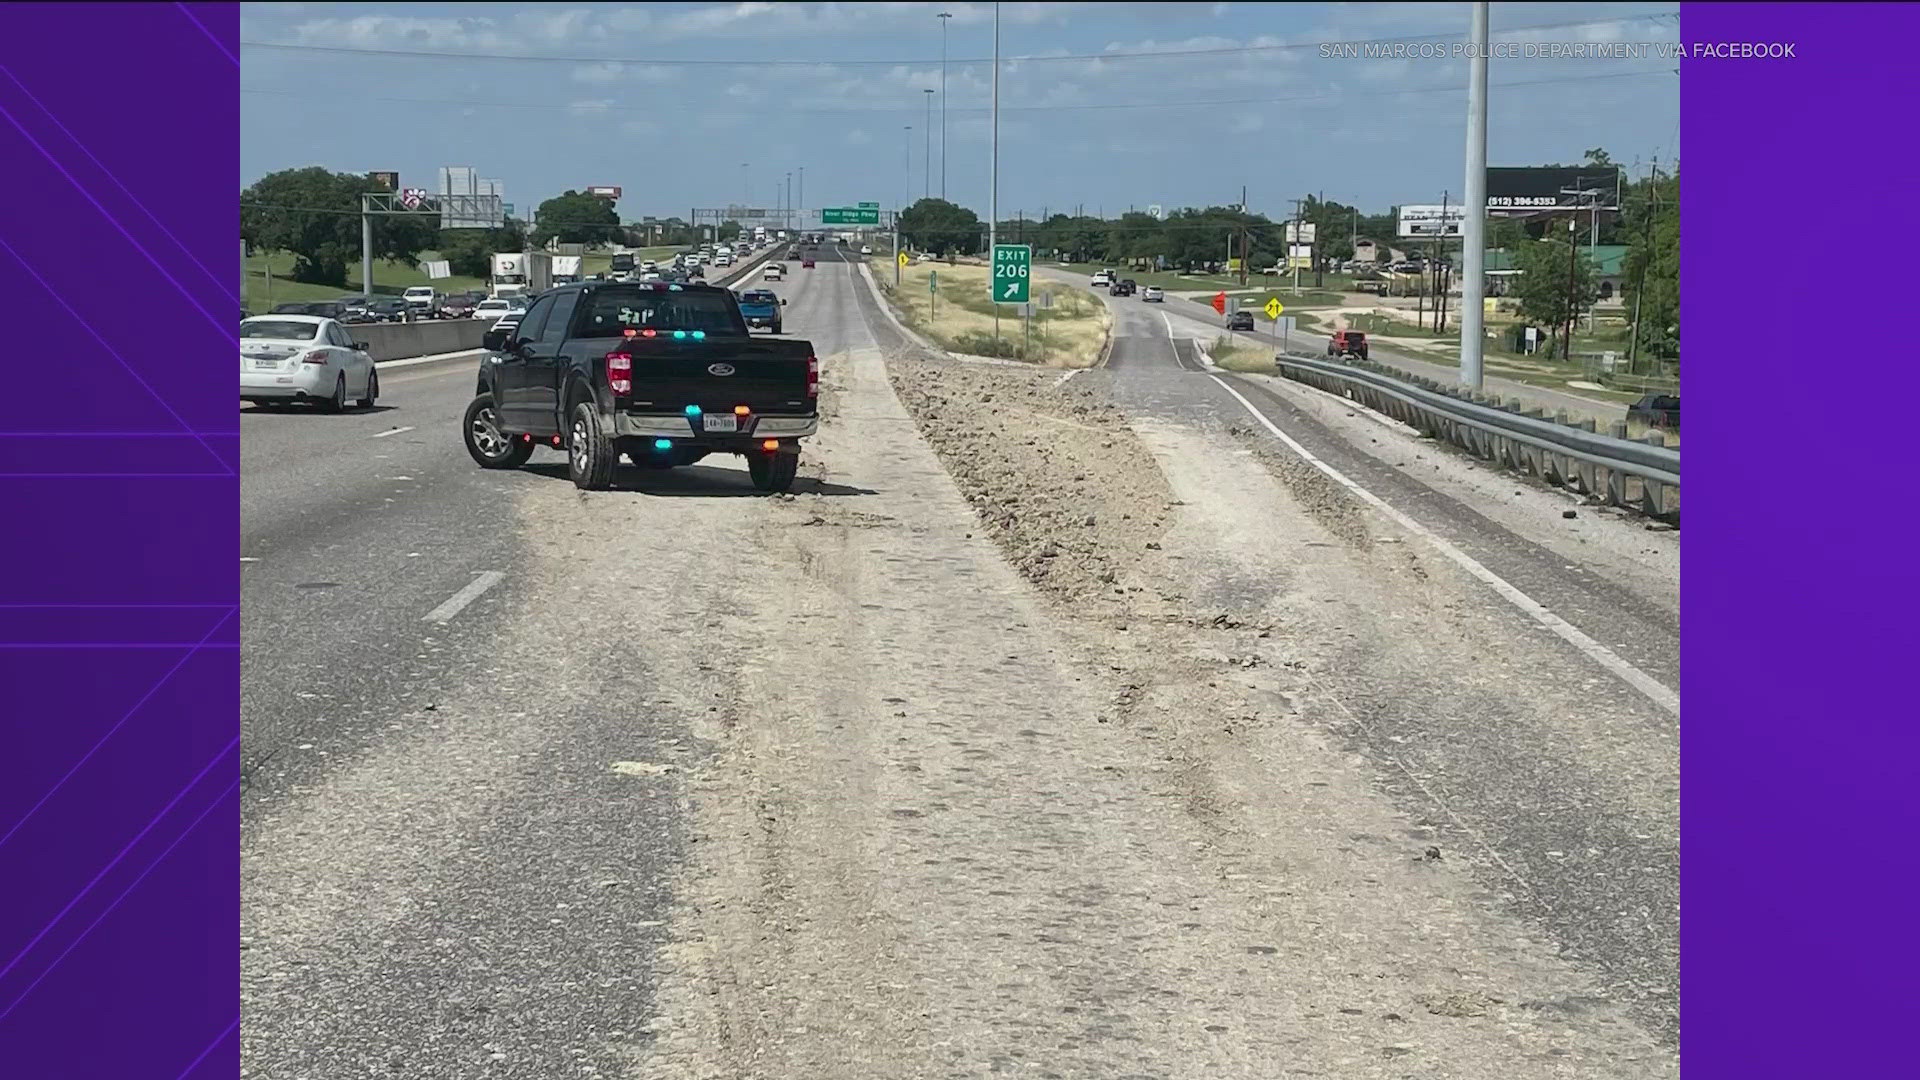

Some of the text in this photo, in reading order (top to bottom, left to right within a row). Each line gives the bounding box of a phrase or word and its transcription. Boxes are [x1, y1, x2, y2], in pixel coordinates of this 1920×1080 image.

[1487, 196, 1512, 206] (512)
[997, 250, 1026, 260] EXIT
[995, 264, 1028, 278] 206
